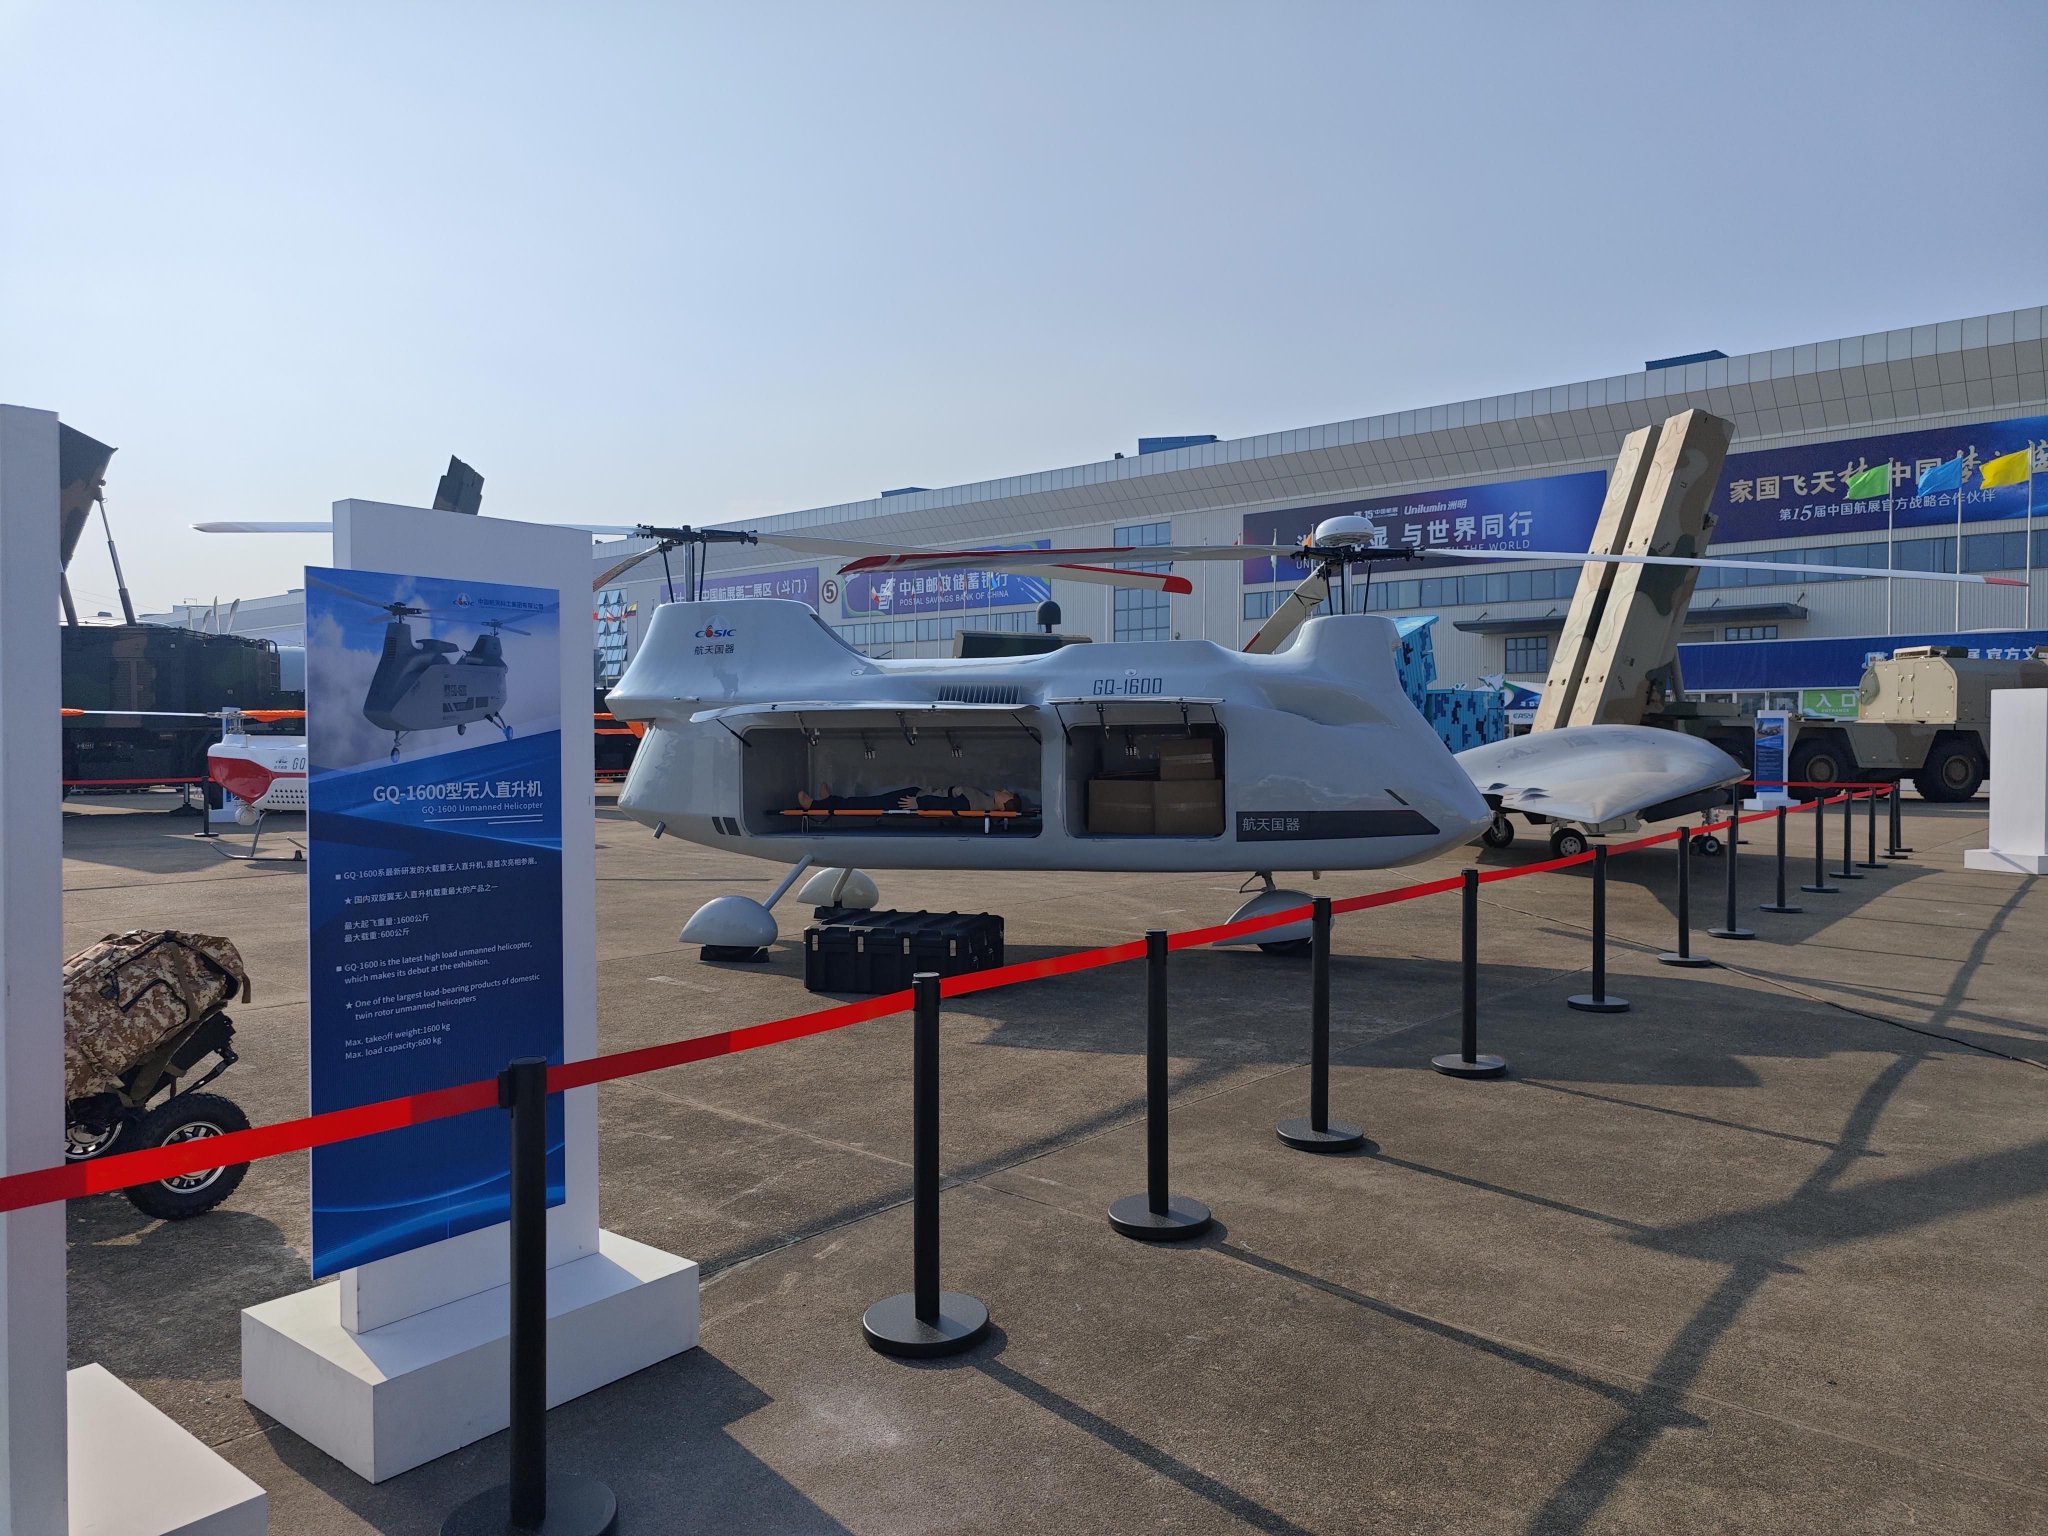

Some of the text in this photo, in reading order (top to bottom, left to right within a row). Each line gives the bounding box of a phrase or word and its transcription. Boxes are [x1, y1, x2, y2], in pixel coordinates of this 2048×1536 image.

[1404, 502, 1447, 515] Unilumin
[1401, 511, 1533, 547] 与世界同行
[1489, 540, 1530, 551] WORLD
[900, 590, 1009, 607] POSTAL SAVINGS BANK OF CHINA
[694, 644, 735, 656] 航天国器
[1093, 677, 1163, 696] GQ-1600
[1816, 693, 1856, 708] 入口
[373, 780, 543, 805] GQ-1600型无人直升机
[422, 801, 543, 815] GQ-1600 Unmanned Helicopter
[1242, 817, 1300, 832] 航天国器
[344, 960, 379, 972] GQ-1600
[380, 959, 387, 967] is
[387, 957, 400, 966] the
[402, 955, 423, 964] latest
[424, 952, 440, 962] high
[441, 950, 458, 959] load
[459, 945, 496, 957] unmanned
[344, 974, 369, 984] which
[370, 971, 395, 981] makes
[396, 969, 406, 977] its
[408, 966, 430, 976] debut
[440, 963, 452, 971] the
[453, 958, 490, 970] exhibition.
[355, 1000, 371, 1008] One
[373, 997, 381, 1005] of
[382, 995, 395, 1003] the
[396, 991, 422, 1002] largest
[423, 985, 469, 997] load-bearing
[470, 979, 501, 991] products
[510, 973, 540, 984] domestic
[355, 995, 477, 1020] twin rotor unmanned helicopters
[365, 1032, 393, 1044] takeoff
[394, 1024, 440, 1038] weight:1600
[441, 1022, 450, 1031] kg
[365, 1046, 383, 1056] load
[384, 1037, 431, 1053] capacity:600
[432, 1036, 442, 1045] kg
